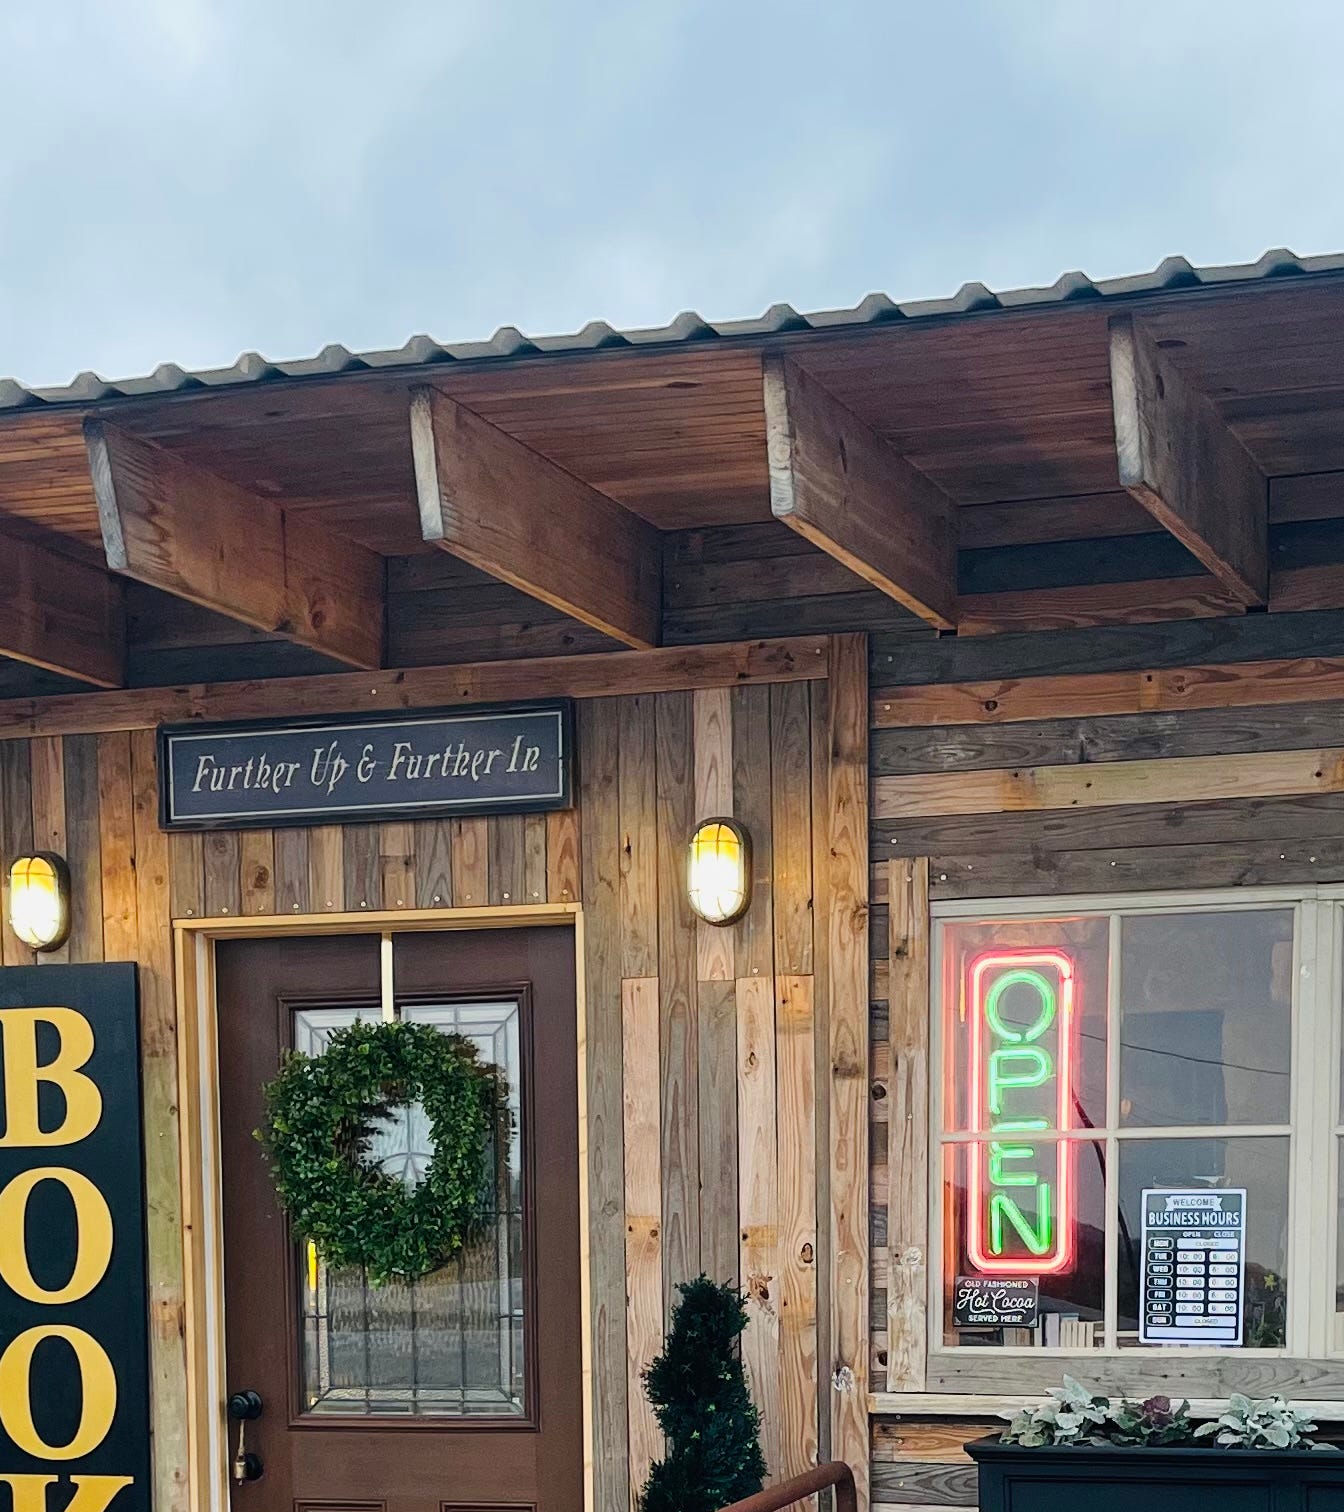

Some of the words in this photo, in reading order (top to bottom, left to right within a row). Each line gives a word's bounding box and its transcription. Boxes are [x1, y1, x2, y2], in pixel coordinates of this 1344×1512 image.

[191, 752, 301, 794] Further
[310, 740, 349, 796] Up
[357, 743, 377, 783] &
[386, 741, 501, 781] Further
[505, 735, 540, 774] In
[985, 969, 1055, 1255] OPEN
[1173, 1198, 1215, 1206] WELCOME
[1149, 1211, 1199, 1225] BUSINESS
[1202, 1211, 1240, 1225] HOURS
[964, 1280, 981, 1288] OLD
[983, 1280, 1029, 1288] FASHIONED
[956, 1289, 995, 1314] Hot
[990, 1289, 1035, 1314] Cocoa
[968, 1315, 999, 1323] SERVED
[1000, 1315, 1023, 1323] HERE
